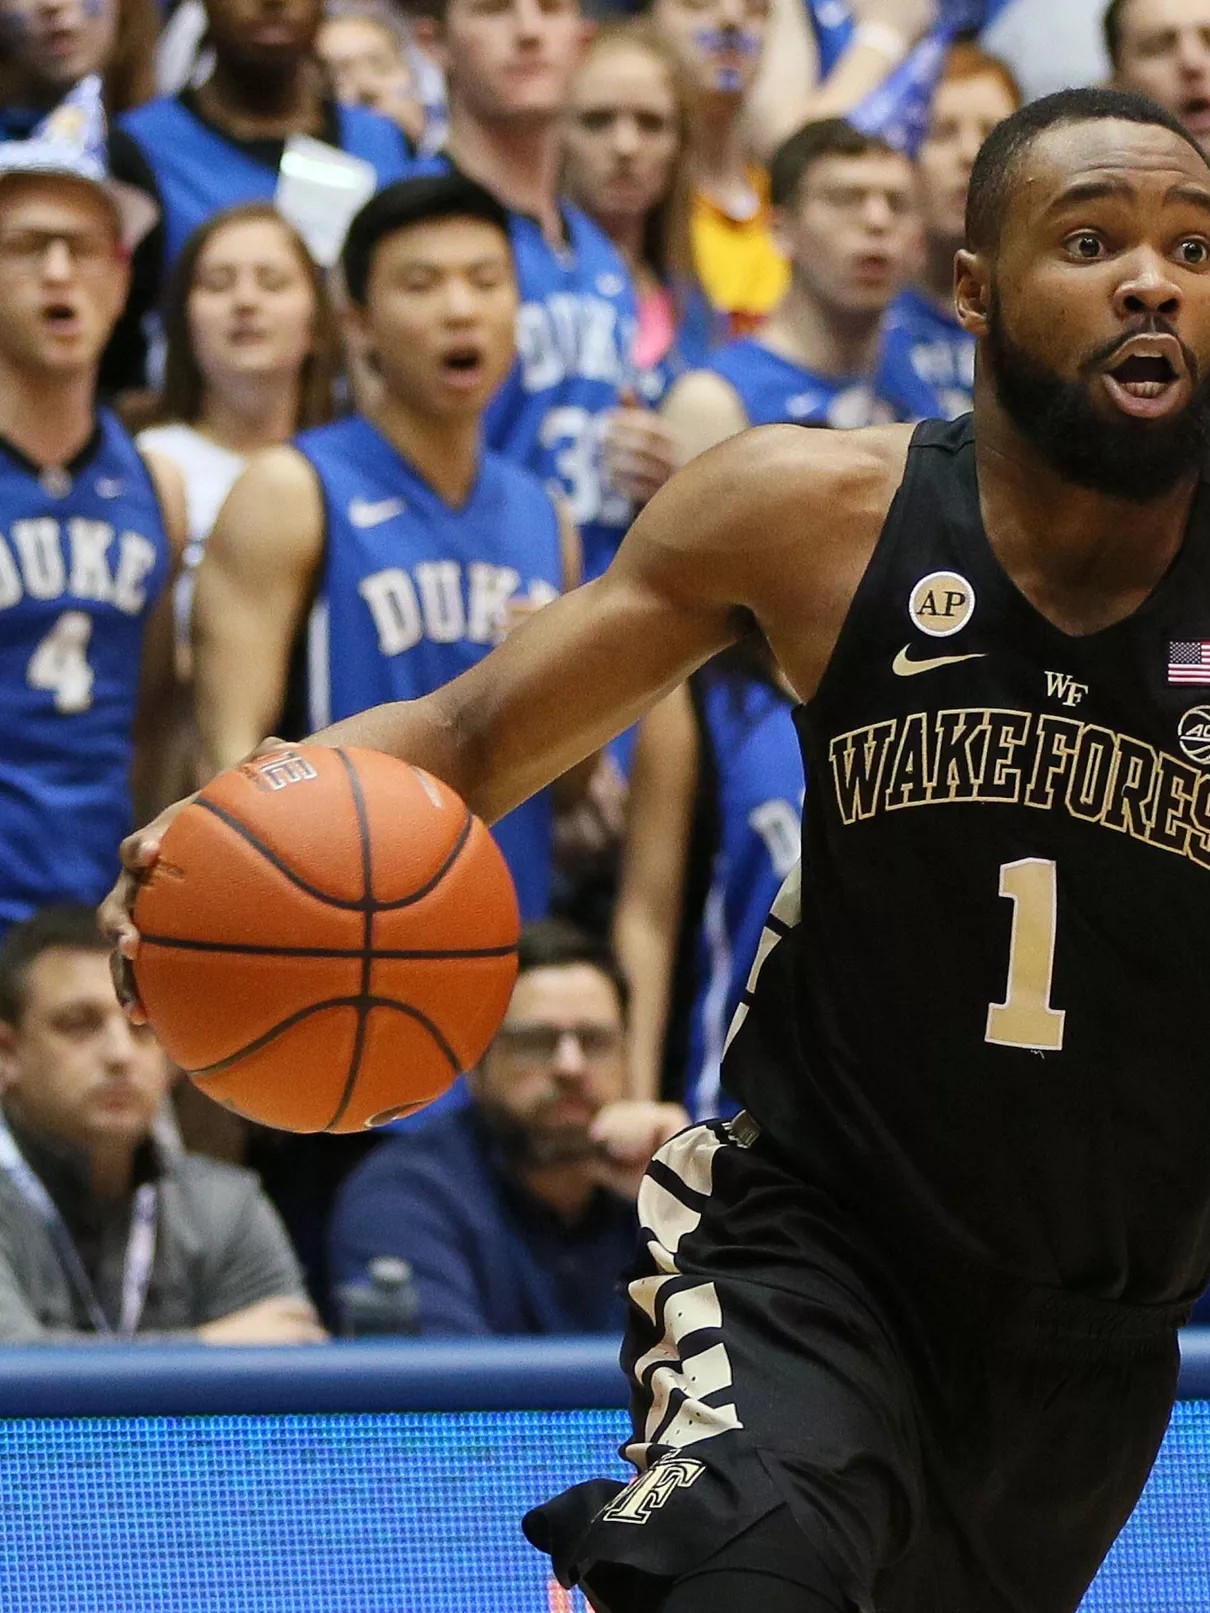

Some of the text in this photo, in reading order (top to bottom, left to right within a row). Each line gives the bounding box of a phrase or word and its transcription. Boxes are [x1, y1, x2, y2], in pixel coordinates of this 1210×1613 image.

[358, 559, 560, 657] DUK
[917, 590, 966, 617] AP
[27, 610, 95, 714] 4
[1044, 670, 1089, 707] WF
[828, 707, 1031, 825] WAKE
[984, 858, 1066, 1050] 1
